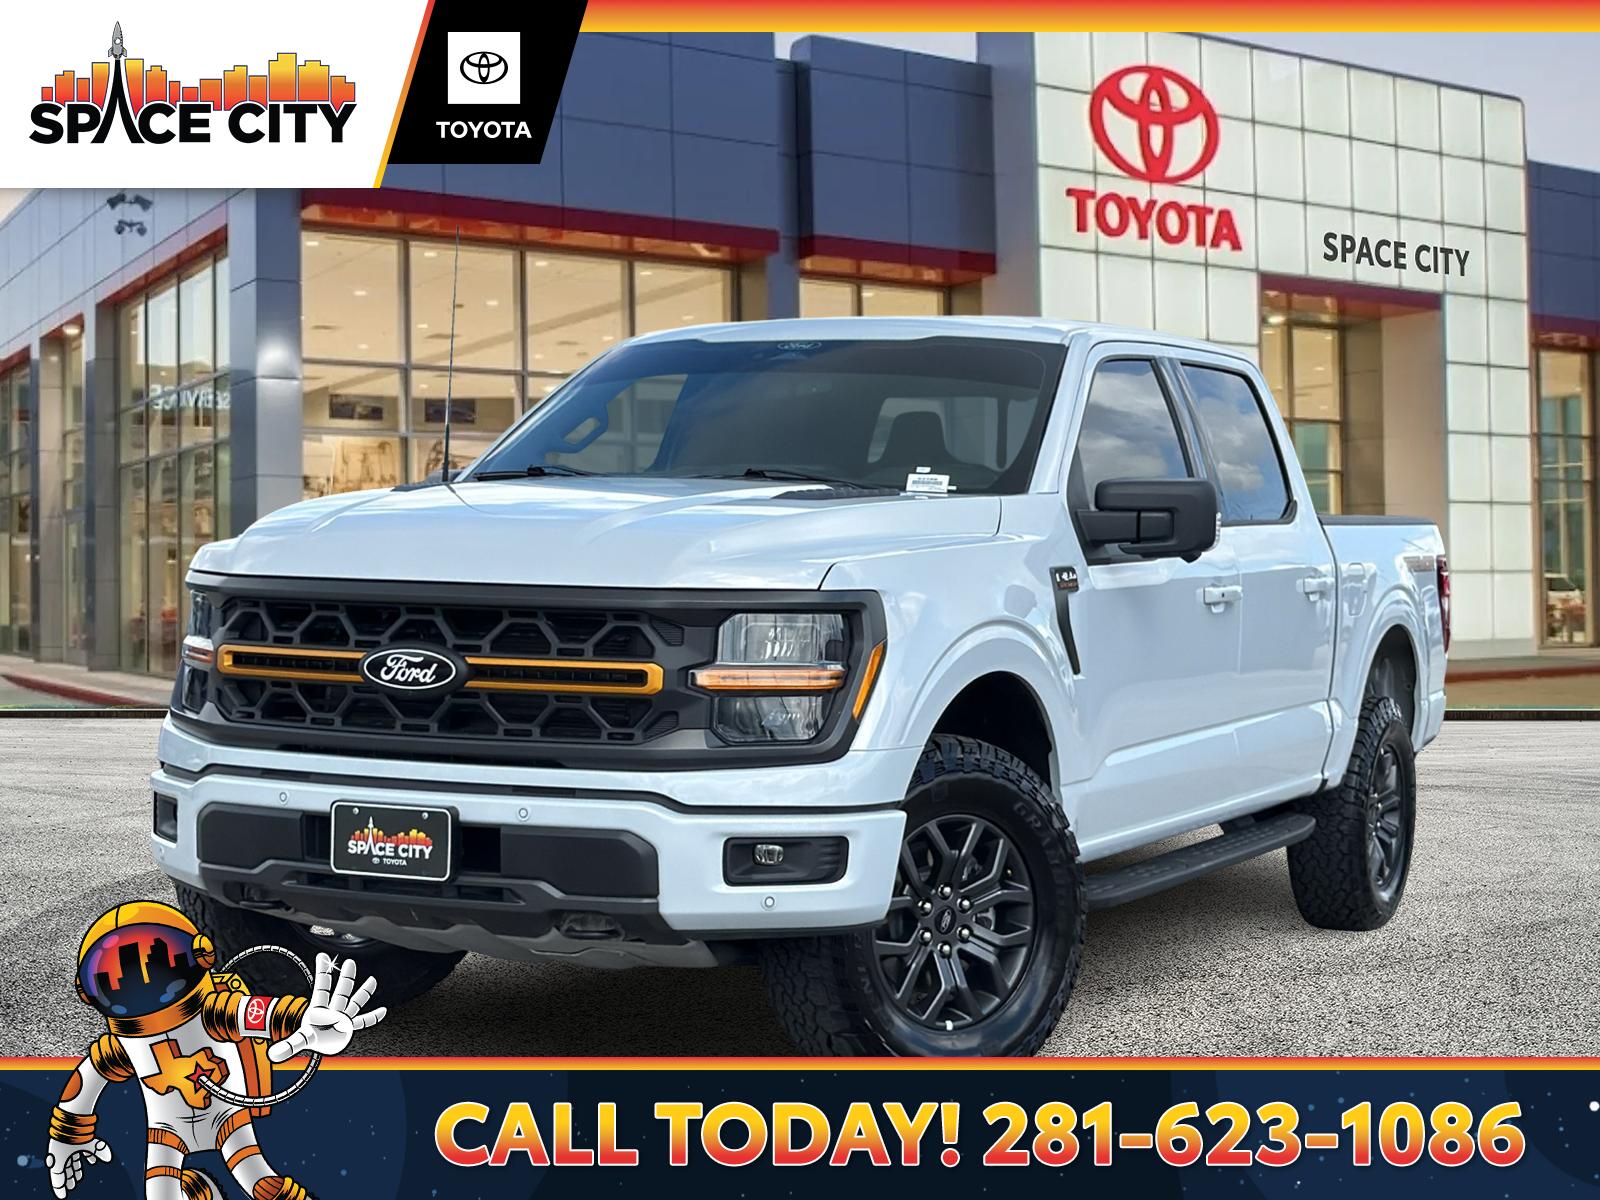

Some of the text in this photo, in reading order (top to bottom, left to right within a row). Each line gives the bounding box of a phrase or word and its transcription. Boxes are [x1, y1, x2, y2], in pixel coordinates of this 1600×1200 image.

[1066, 187, 1243, 252] TOYOTA
[1322, 231, 1470, 277] SPACE CITY
[380, 653, 438, 683] Ford
[347, 839, 433, 860] SPACE CITY
[382, 858, 408, 867] TOYOTA
